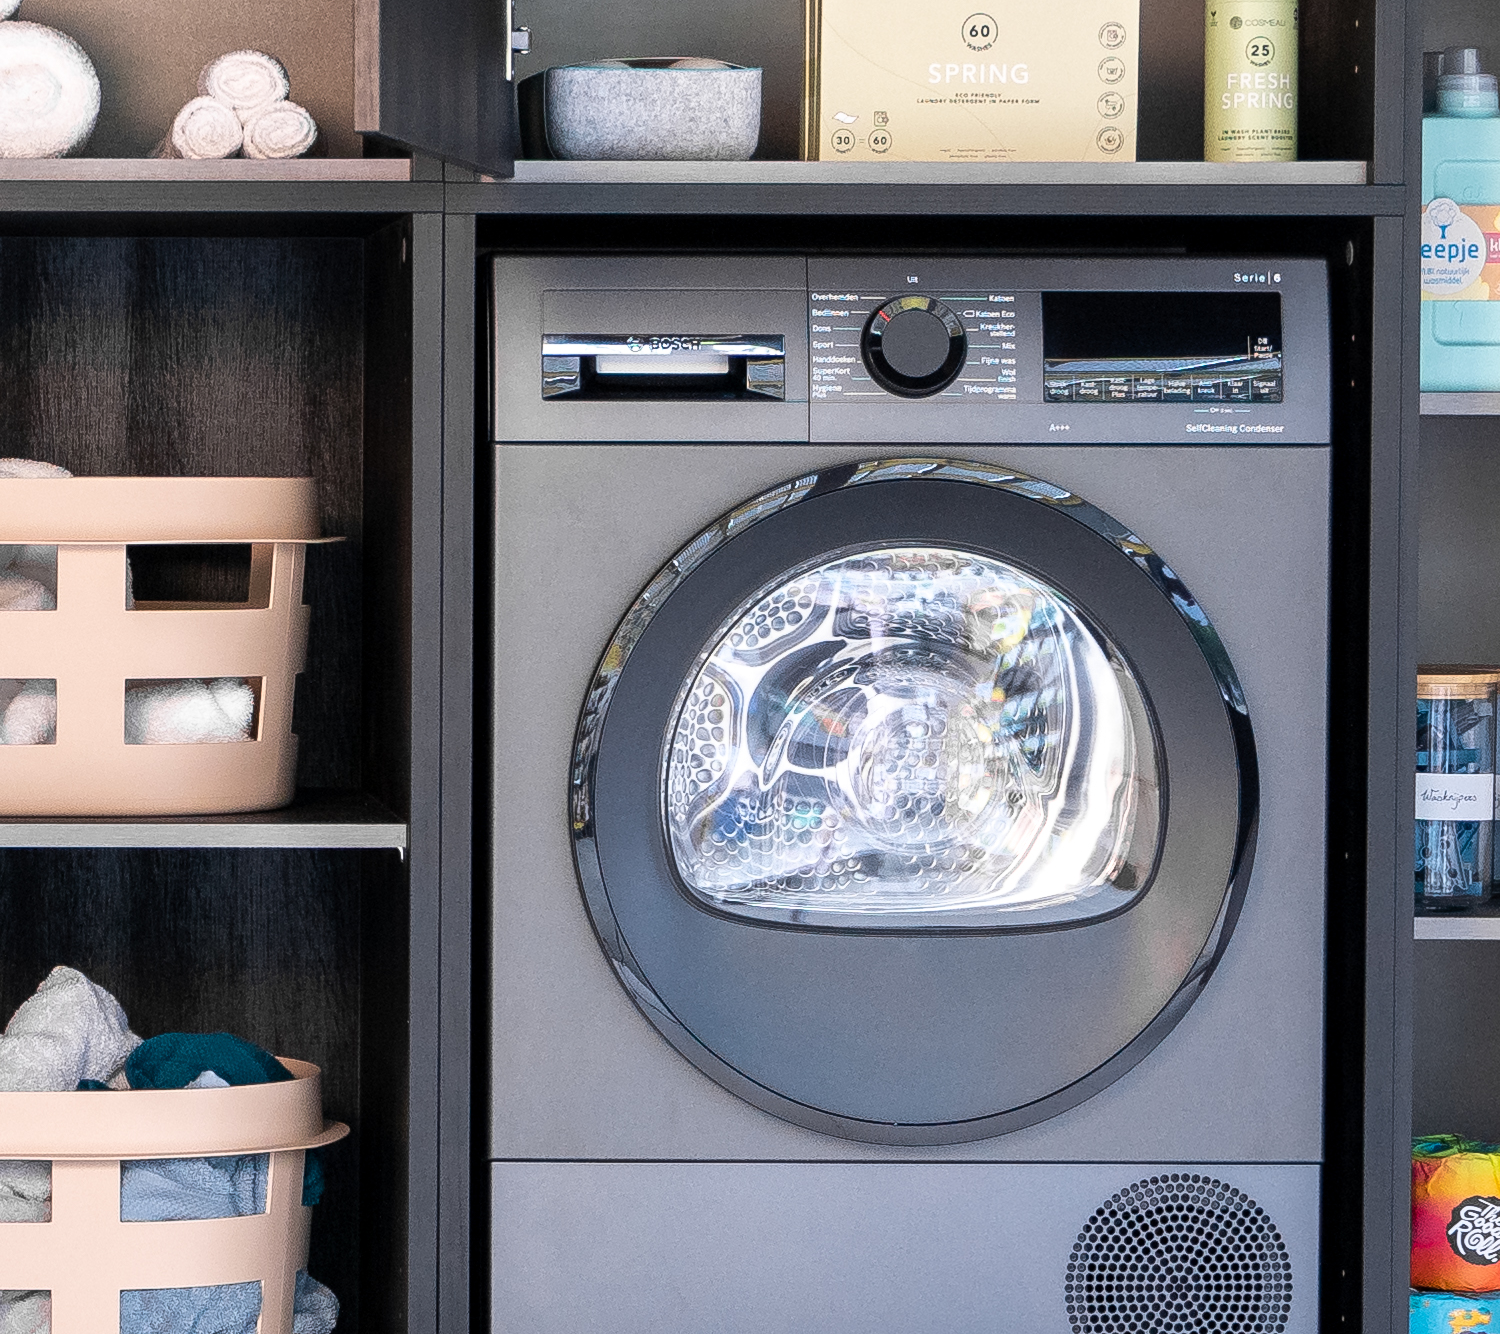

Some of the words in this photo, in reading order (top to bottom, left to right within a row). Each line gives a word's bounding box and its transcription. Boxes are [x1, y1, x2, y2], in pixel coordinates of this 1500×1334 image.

[1244, 18, 1286, 27] COSMEAU
[969, 24, 991, 38] 60
[1250, 44, 1270, 57] 25
[927, 63, 1030, 85] SPRING
[1227, 72, 1290, 89] FRESH
[1221, 91, 1294, 110] SPRING
[836, 136, 851, 145] 30
[873, 136, 888, 145] 60
[1233, 273, 1266, 284] Serie
[1273, 273, 1282, 283] 6
[811, 293, 859, 302] Overhemden
[975, 310, 1001, 318] Katoen
[1001, 310, 1016, 318] Eco
[812, 324, 832, 332] Dons
[649, 336, 702, 351] BOSCH
[812, 340, 834, 349] Sport
[1001, 342, 1016, 350] Mix
[812, 355, 856, 364] Handdoeken
[980, 357, 999, 365] Fijne
[1000, 357, 1016, 365] was
[812, 367, 851, 376] SuperKort
[1253, 380, 1276, 388] Signaal
[812, 385, 843, 393] Hygiene
[963, 385, 1017, 394] Tijdprogramma
[1049, 424, 1070, 432] A+++
[1185, 423, 1238, 434] SelfCleaning
[1239, 424, 1284, 433] Condenser
